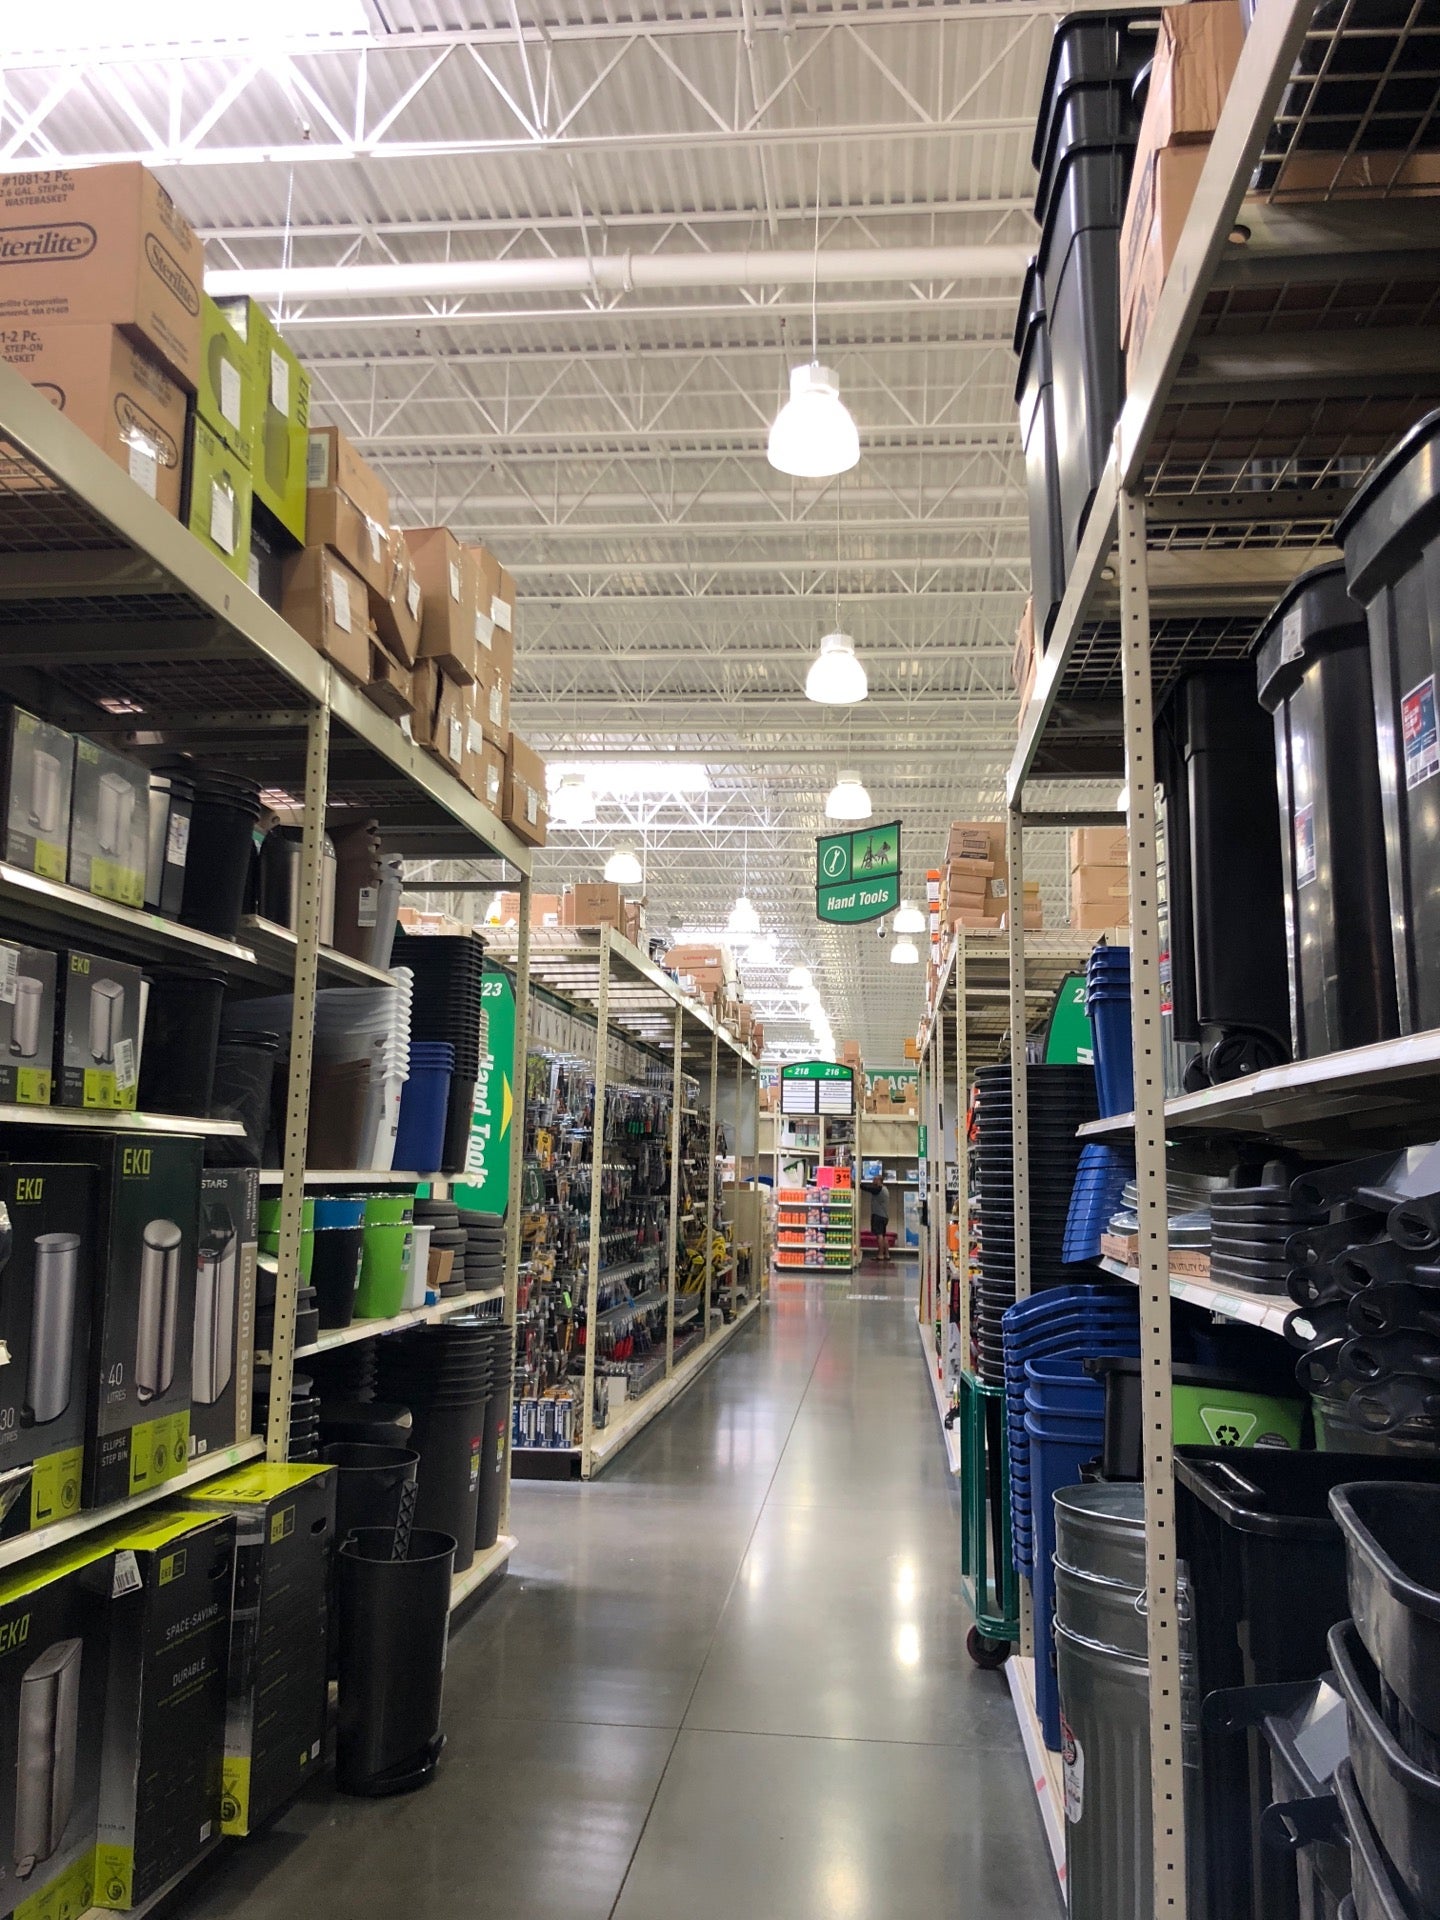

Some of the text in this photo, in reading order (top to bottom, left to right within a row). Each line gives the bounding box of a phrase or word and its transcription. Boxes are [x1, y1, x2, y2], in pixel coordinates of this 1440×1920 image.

[2, 171, 73, 187] #1081-2 Pc.
[38, 183, 75, 194] STEP-ON
[5, 193, 68, 207] WASTEBASKET
[0, 230, 82, 257] terilite
[152, 244, 195, 309] Sterilite
[23, 330, 41, 342] Pc.
[5, 343, 44, 353] STEP-ON
[297, 377, 309, 428] EKO
[827, 889, 889, 911] Hand Tools
[71, 955, 90, 974] EKO
[1073, 988, 1087, 1003] 2
[825, 1068, 840, 1076] 216
[864, 1075, 918, 1090] AAGE
[123, 1148, 151, 1174] EKO
[464, 1123, 491, 1189] Tools
[835, 1173, 842, 1184] 3
[16, 1178, 43, 1200] EKO
[239, 1255, 252, 1434] motion sensor
[108, 1362, 123, 1386] 40
[107, 1389, 127, 1404] LITRES
[0, 1407, 14, 1430] 30
[103, 1436, 127, 1452] ELLIPSE
[102, 1450, 128, 1467] STEP BIN
[166, 1602, 219, 1641] SPACE-SAVING
[0, 1613, 30, 1651] EKO
[172, 1657, 206, 1688] DURABLE
